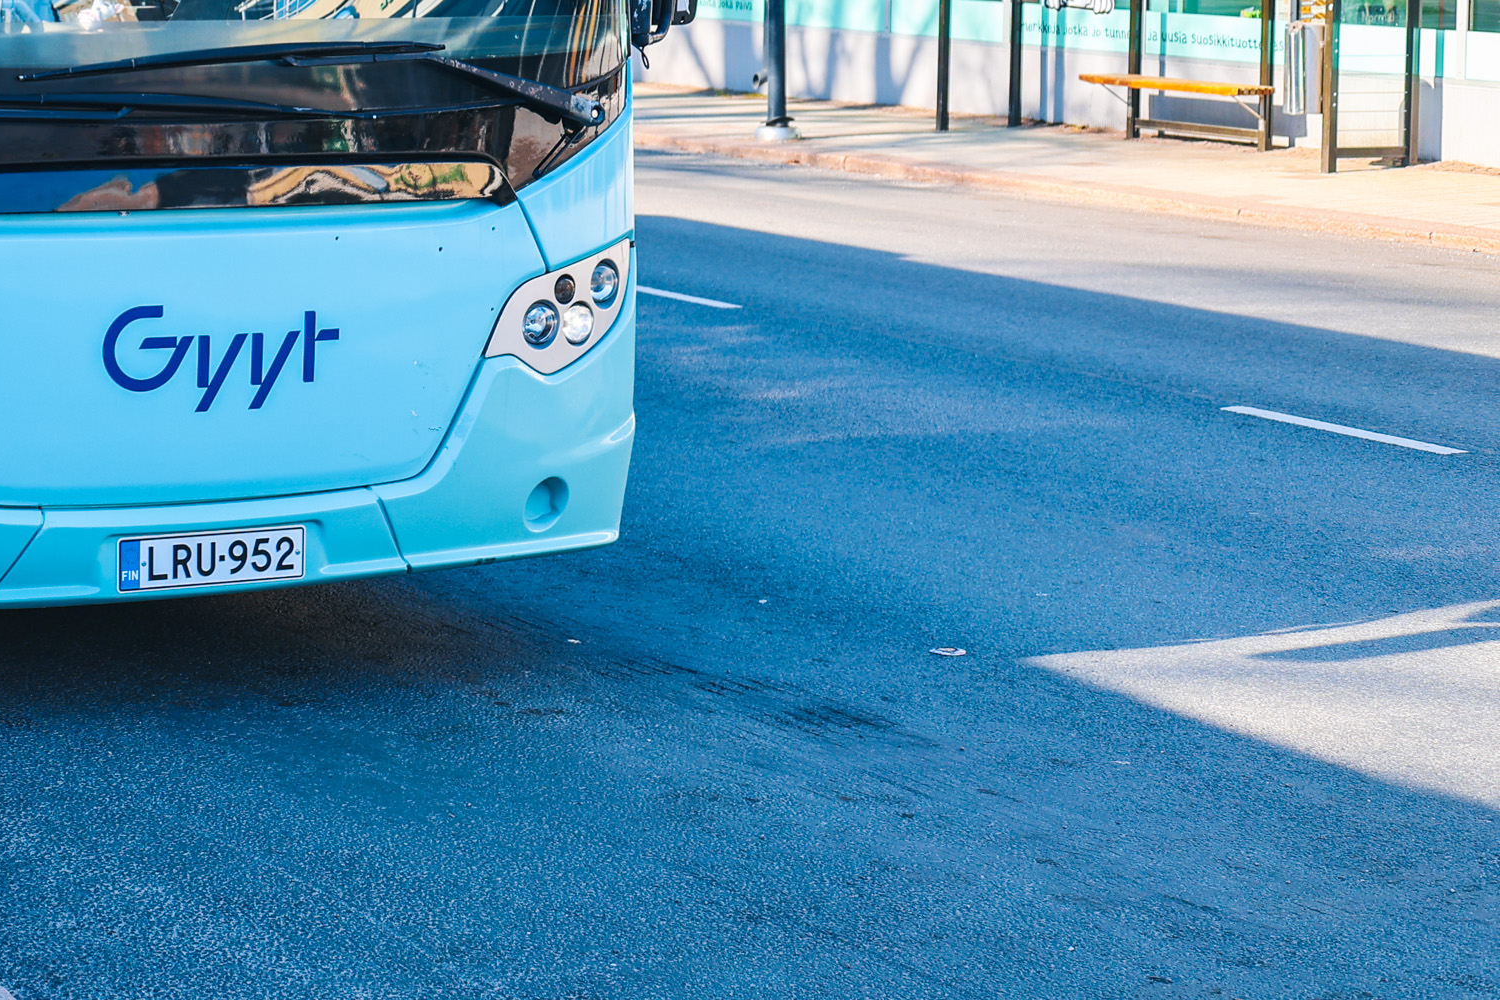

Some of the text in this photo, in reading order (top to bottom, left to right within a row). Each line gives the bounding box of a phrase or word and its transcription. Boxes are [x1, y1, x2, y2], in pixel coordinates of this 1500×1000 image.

[1105, 26, 1131, 40] tunne
[1161, 31, 1188, 45] uusia
[102, 305, 340, 413] Gyyt
[148, 536, 295, 582] LRU-952
[121, 570, 139, 582] FIN
